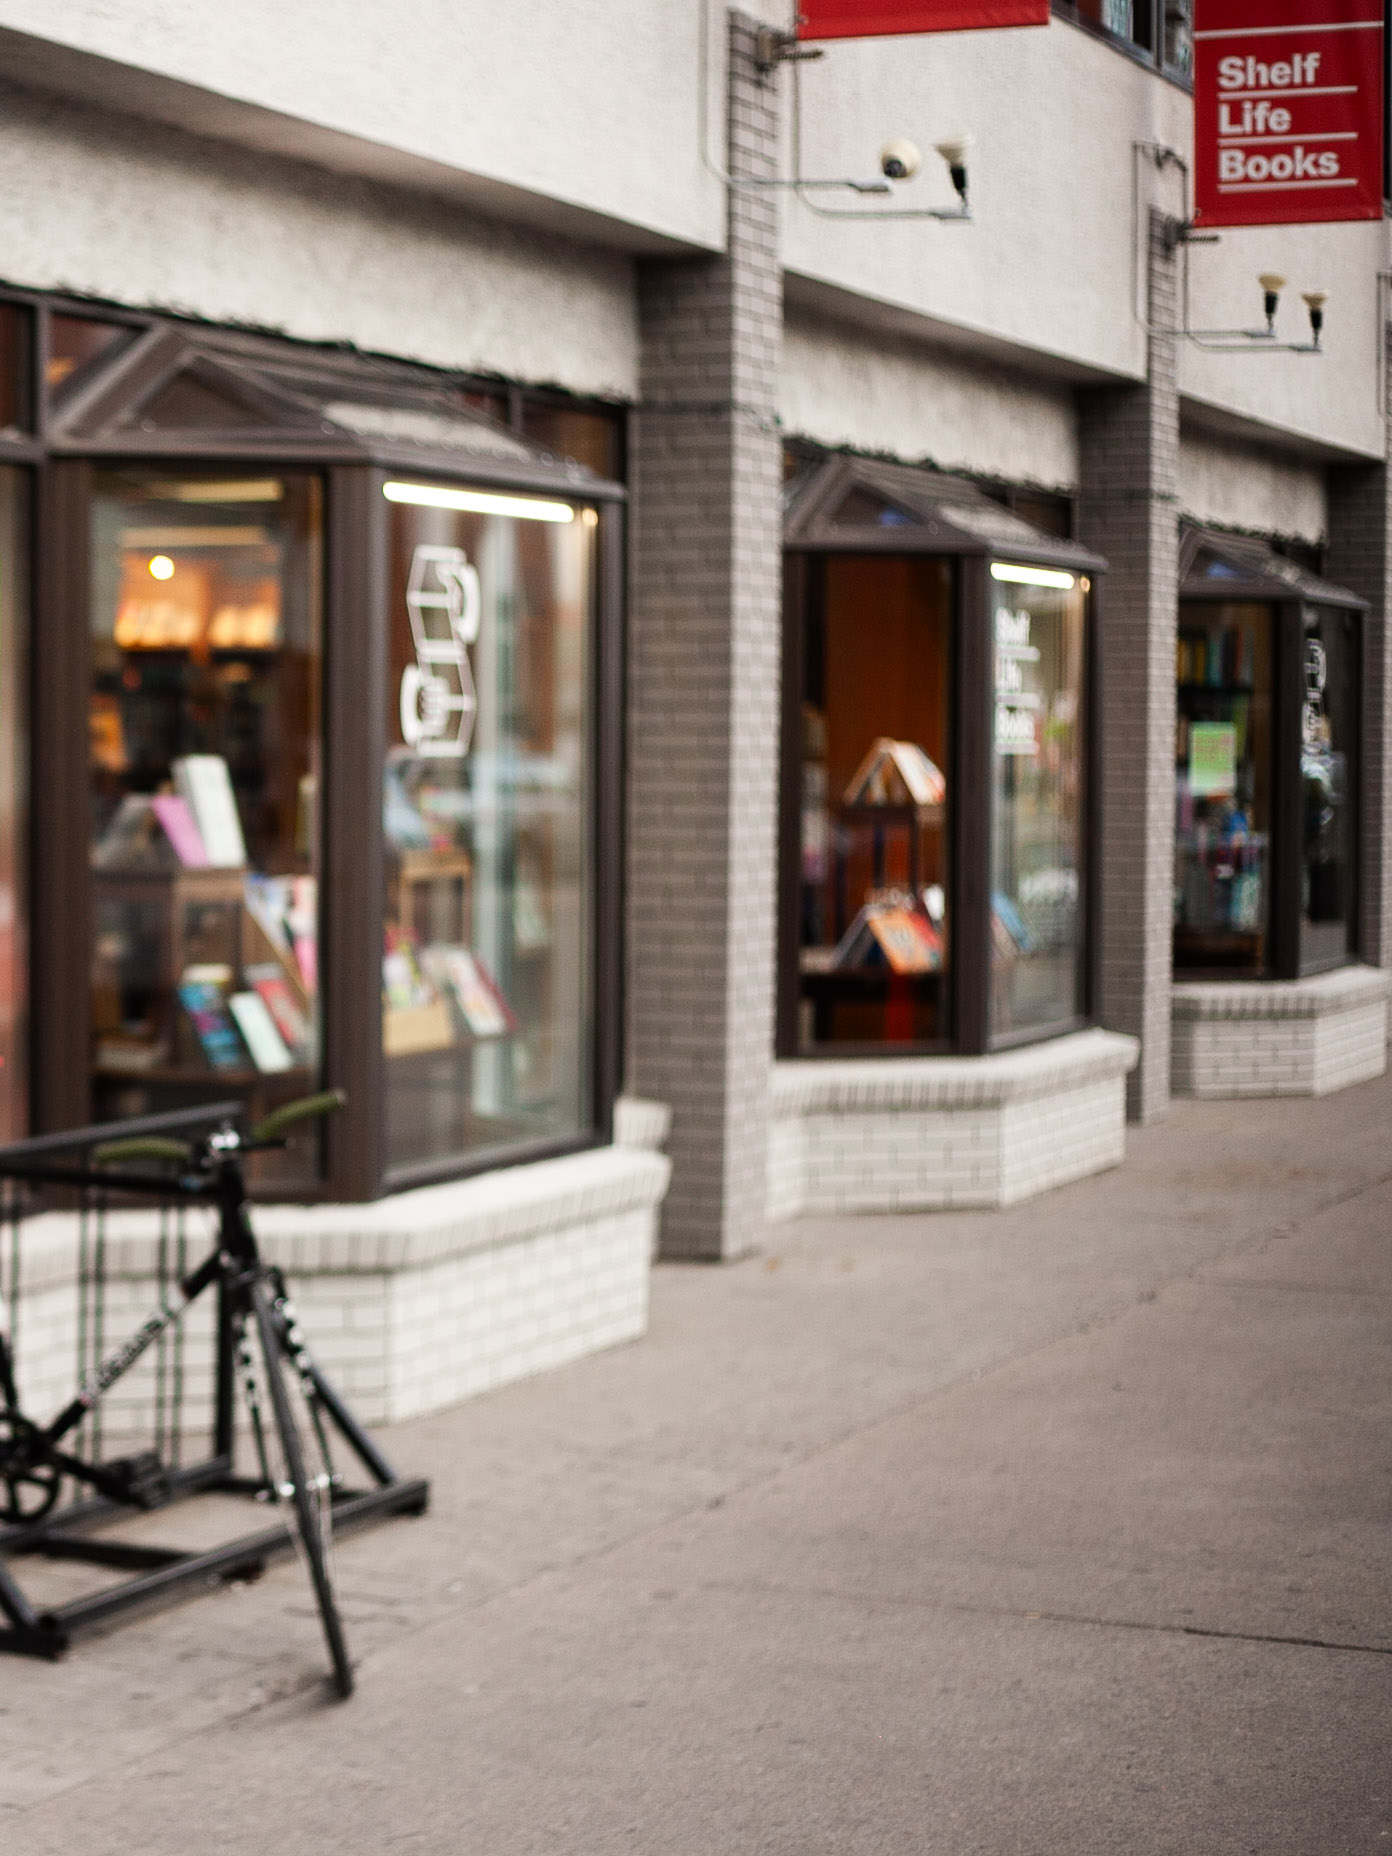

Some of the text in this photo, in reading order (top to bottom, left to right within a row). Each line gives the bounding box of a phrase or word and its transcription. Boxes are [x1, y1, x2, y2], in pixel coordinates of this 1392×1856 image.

[1218, 52, 1321, 90] Shelf
[1218, 101, 1292, 135] Life
[1218, 145, 1340, 182] Books
